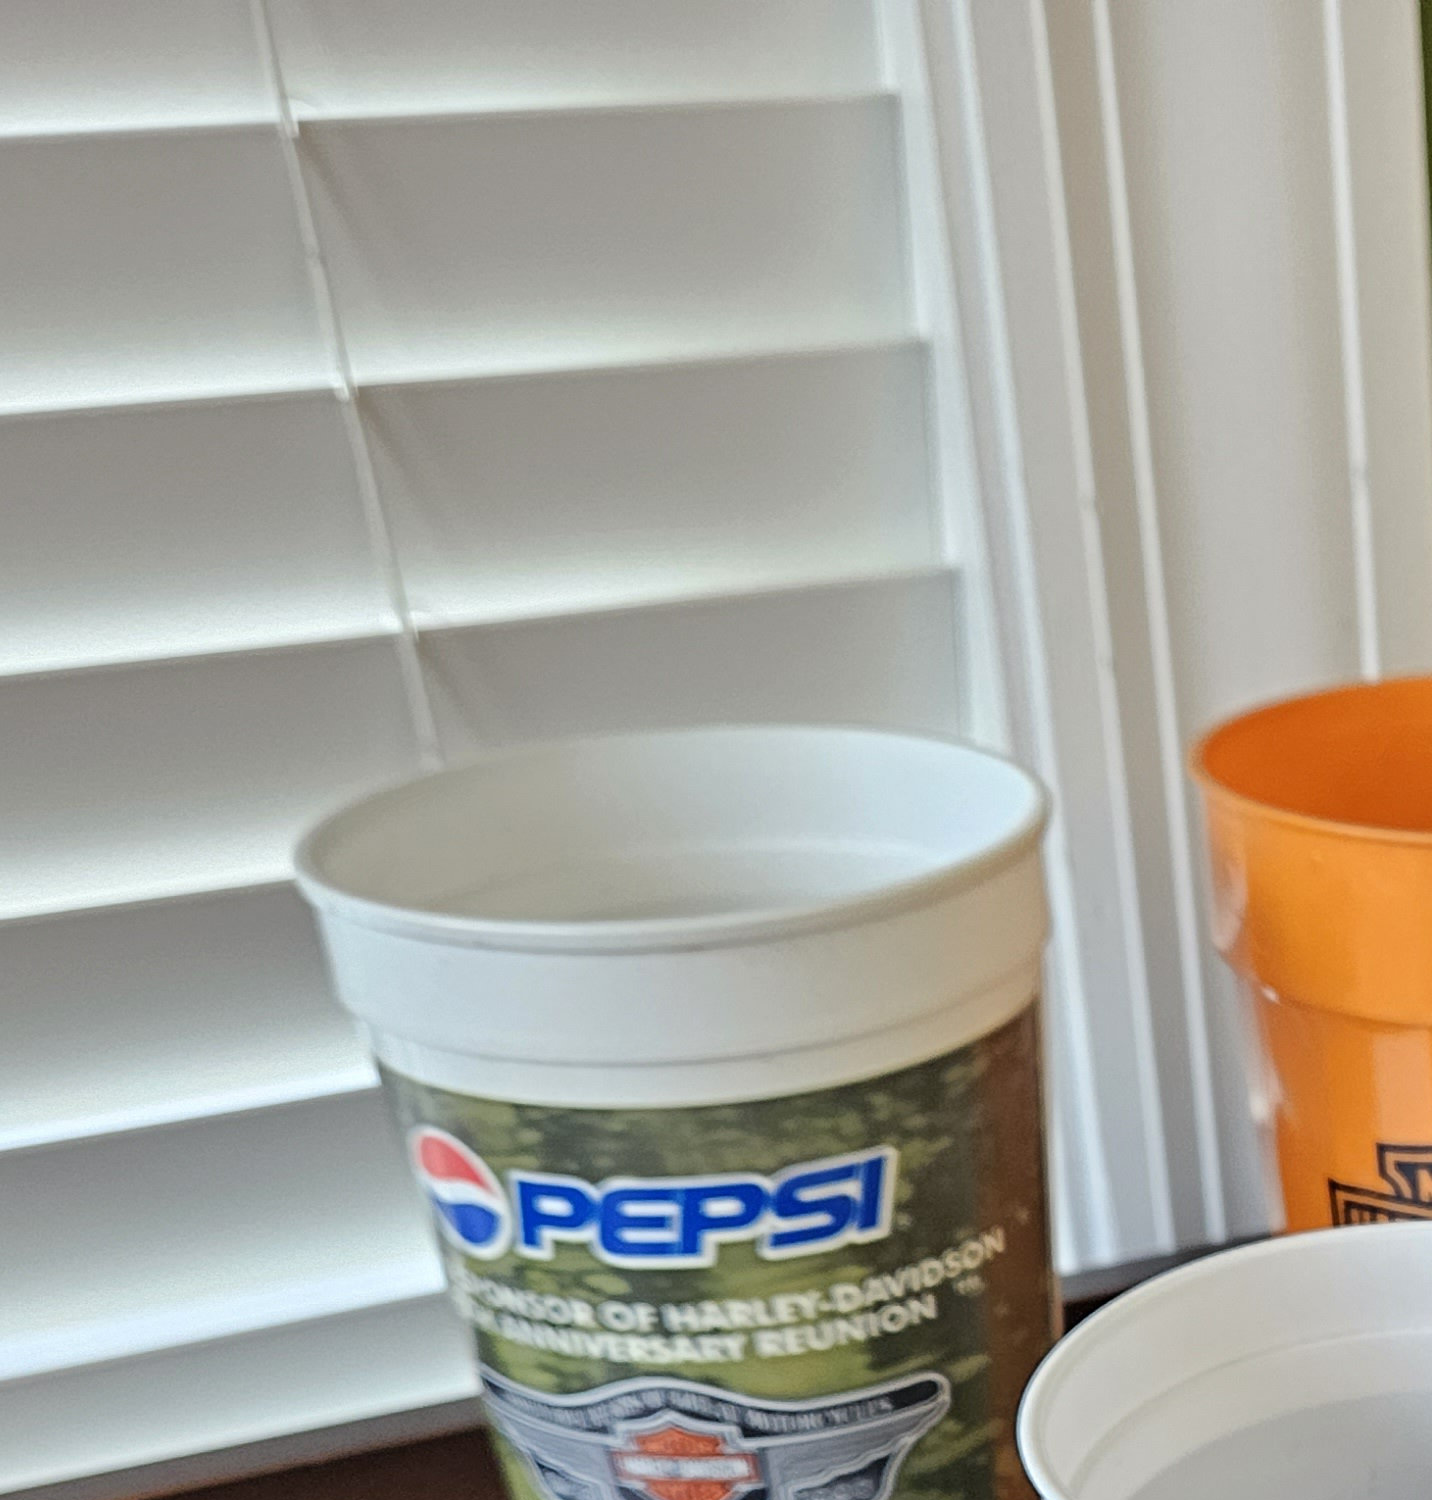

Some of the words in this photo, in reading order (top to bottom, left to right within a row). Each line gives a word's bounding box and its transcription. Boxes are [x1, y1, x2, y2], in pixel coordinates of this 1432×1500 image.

[512, 1150, 896, 1264] PEPSI
[501, 1312, 745, 1364] ANNIVERSARY
[752, 1294, 937, 1358] REUNION
[599, 1300, 659, 1331] OF
[661, 1226, 1006, 1333] HARLEY-DAVIDSON
